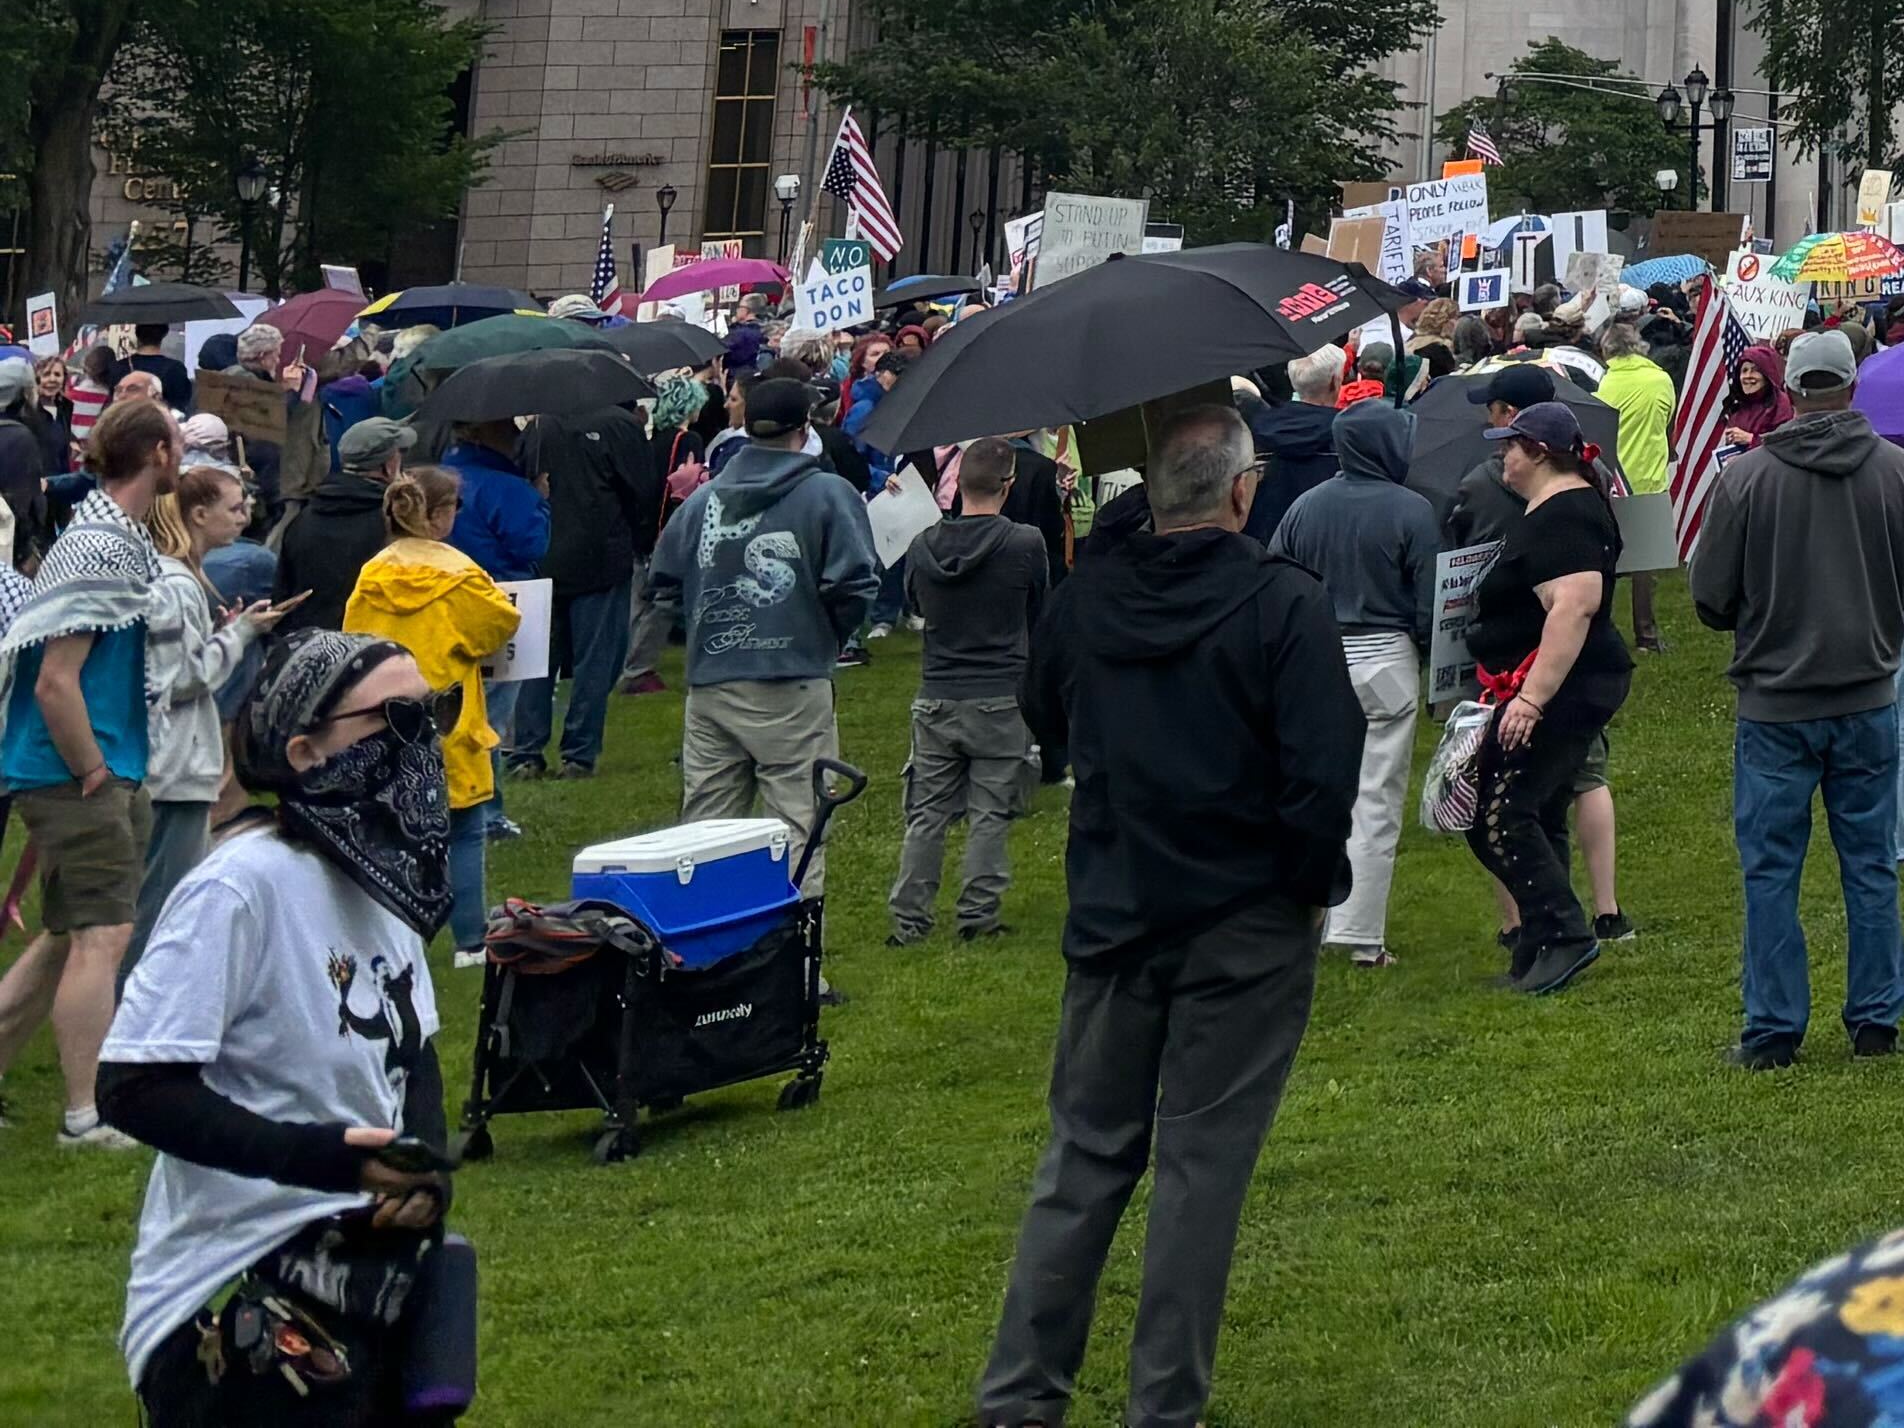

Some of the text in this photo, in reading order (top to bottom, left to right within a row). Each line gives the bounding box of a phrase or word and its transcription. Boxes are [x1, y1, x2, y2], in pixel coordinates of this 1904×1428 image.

[1409, 181, 1448, 203] ONLY
[1055, 204, 1104, 226] STAND
[1409, 204, 1444, 222] PEOPLE
[830, 246, 864, 266] NO
[806, 276, 865, 305] TACO
[1769, 290, 1806, 310] KING
[814, 299, 862, 328] DON
